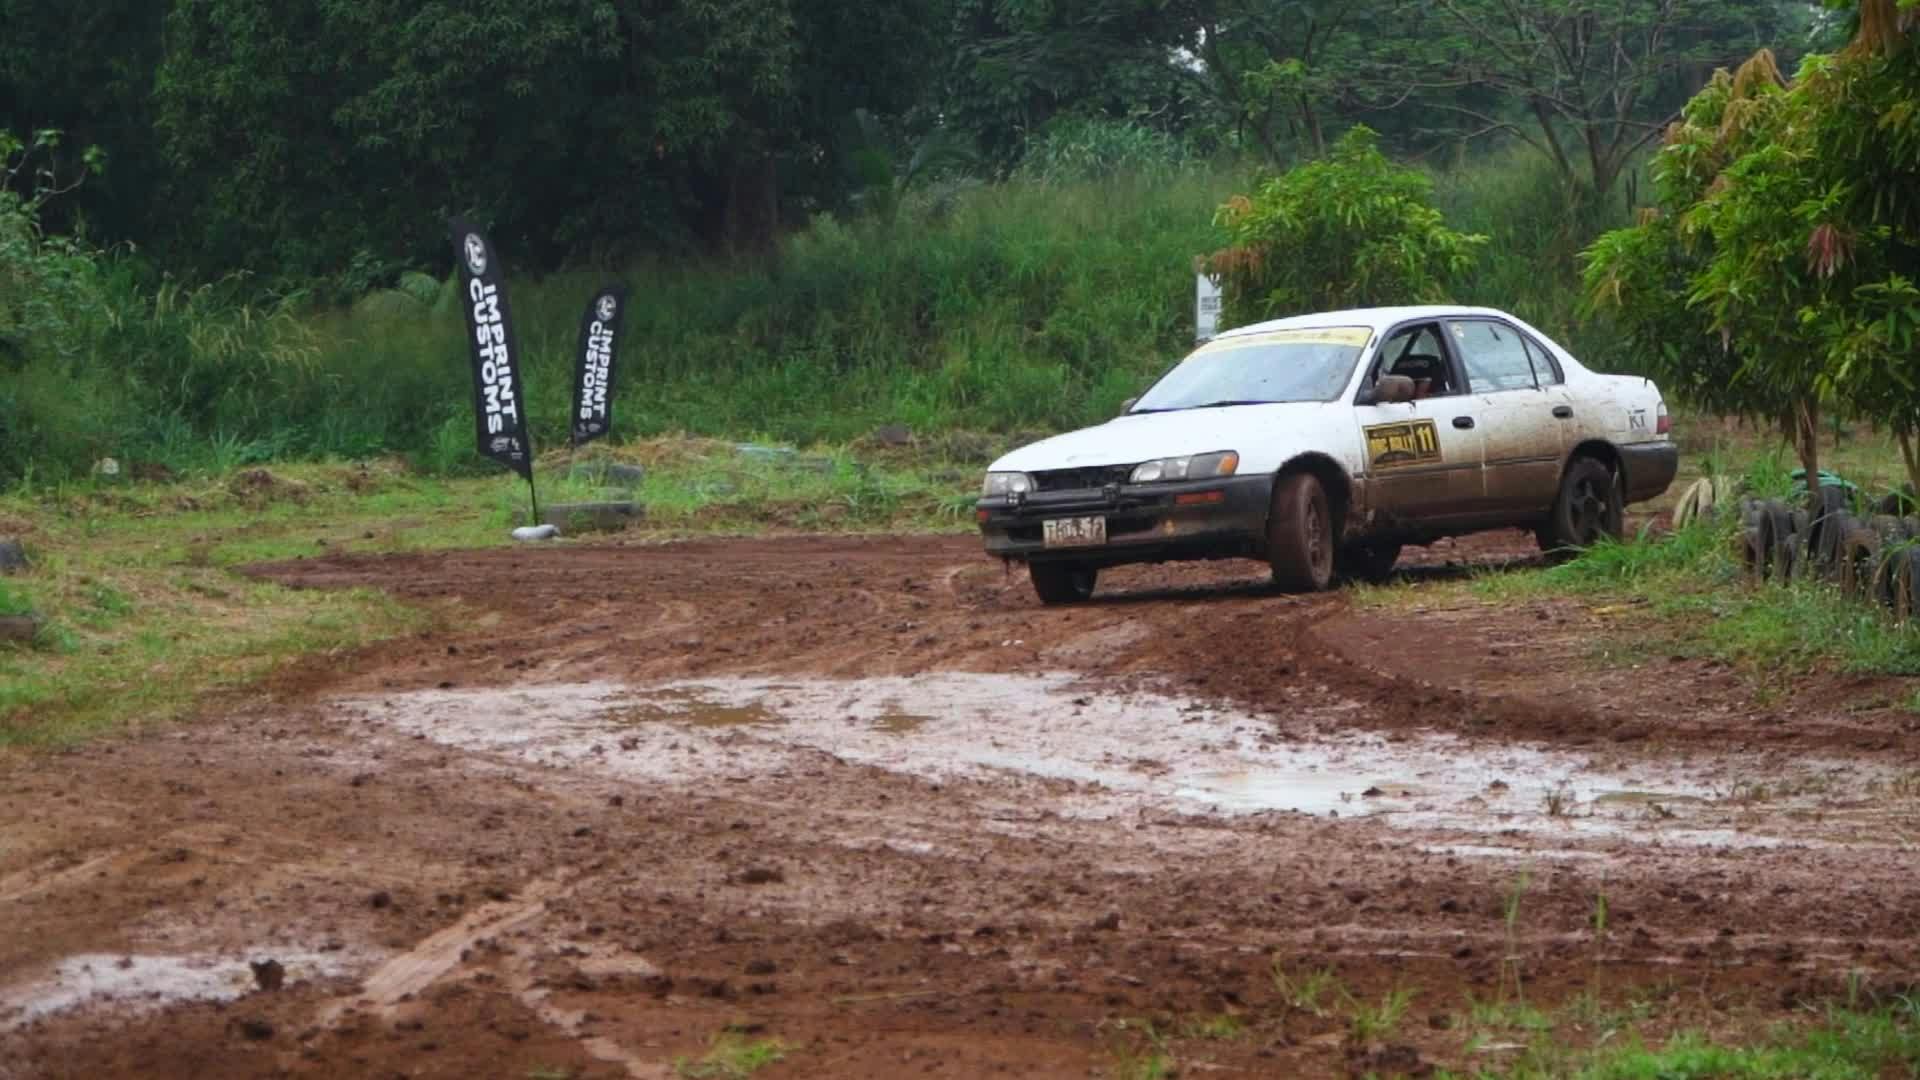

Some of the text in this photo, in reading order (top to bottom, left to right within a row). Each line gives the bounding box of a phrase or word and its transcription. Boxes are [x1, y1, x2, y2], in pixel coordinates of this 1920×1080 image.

[469, 277, 503, 434] CUSTOMS
[483, 284, 517, 421] IMPRINT
[580, 320, 602, 420] CUSTOMS
[593, 329, 614, 418] IMPRINT
[1417, 426, 1434, 452] 11
